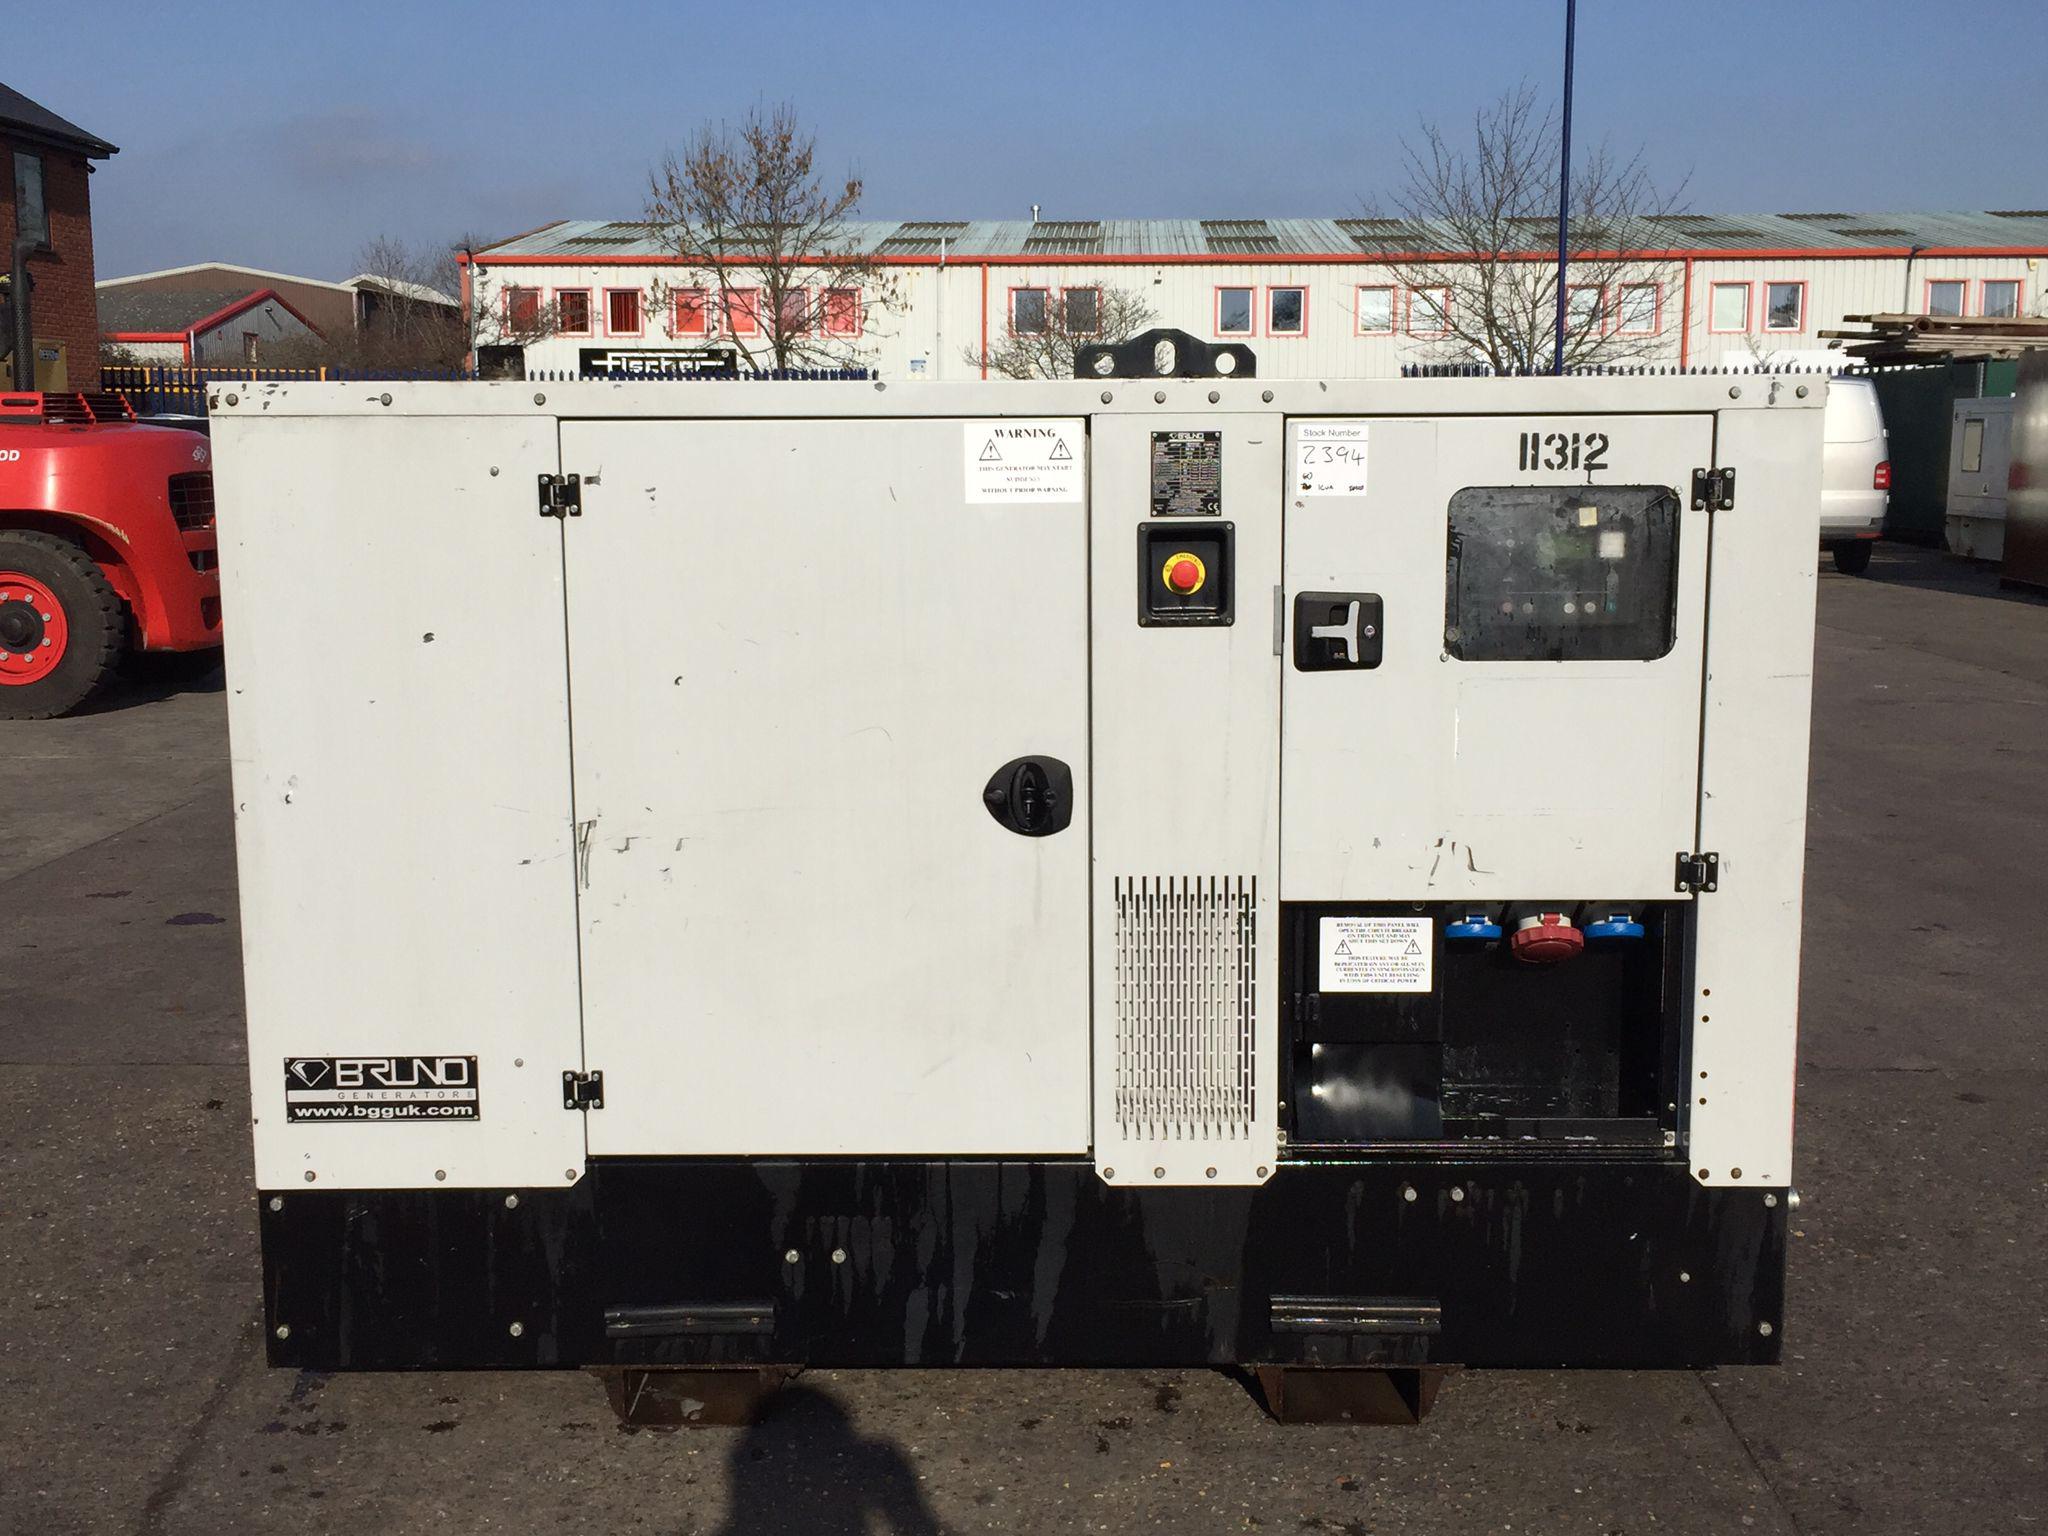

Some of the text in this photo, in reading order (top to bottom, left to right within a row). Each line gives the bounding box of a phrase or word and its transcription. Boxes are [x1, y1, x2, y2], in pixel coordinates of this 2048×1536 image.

[995, 428, 1056, 438] WARNING
[1178, 432, 1204, 440] BRUNO
[1304, 429, 1361, 437] Stock Number
[1303, 446, 1365, 466] 2394
[1519, 432, 1609, 472] 11312
[335, 1059, 469, 1086] BRUNO
[295, 1104, 473, 1119] www.bgguk.com
